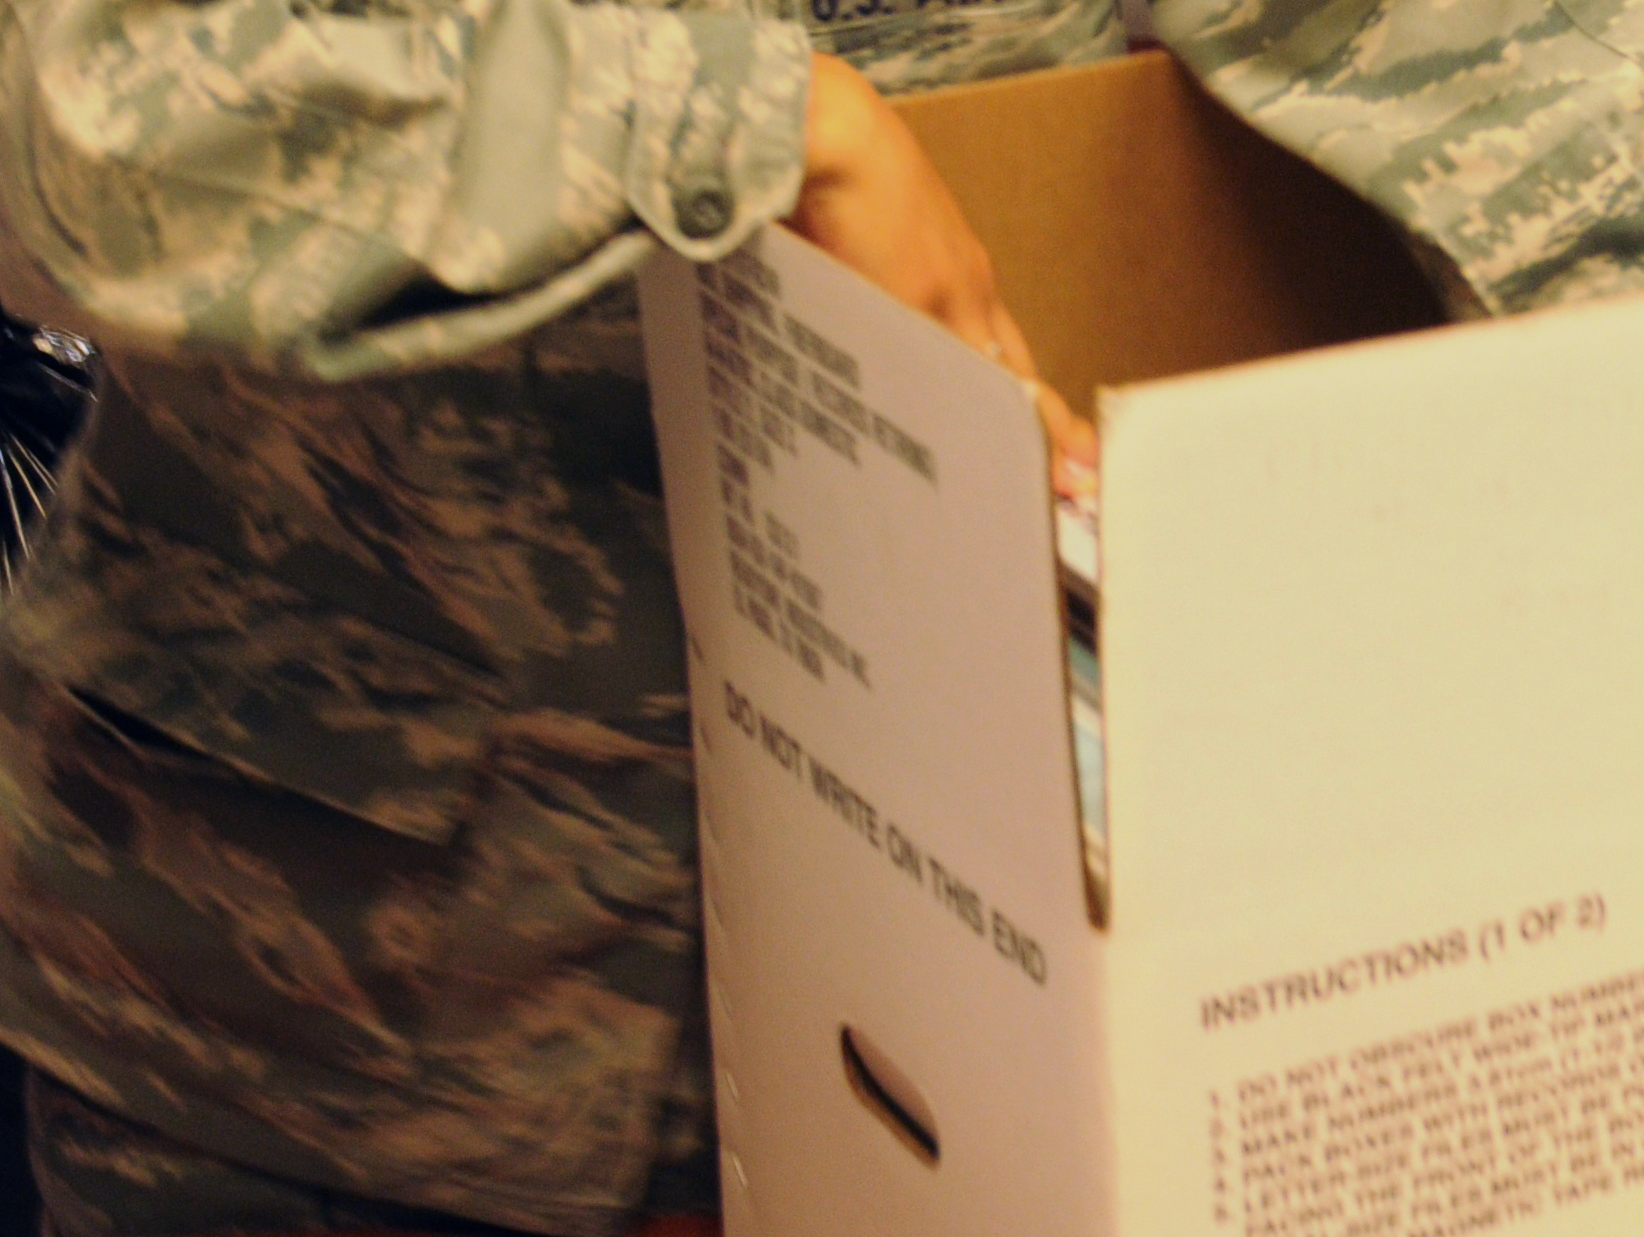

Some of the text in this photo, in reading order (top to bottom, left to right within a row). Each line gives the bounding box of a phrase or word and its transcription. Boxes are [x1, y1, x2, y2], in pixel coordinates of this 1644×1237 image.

[724, 680, 1047, 988] DO NOT WRITE ON THIS END
[1200, 889, 1607, 1032] INSTRUCTIONS (1 OF 2)
[1239, 1071, 1278, 1101] DO
[1285, 1054, 1337, 1088] NOT
[1349, 1015, 1477, 1070] OBSCURE
[1489, 998, 1540, 1031] BOX
[1303, 1070, 1392, 1113] BLACK
[1403, 1050, 1463, 1084] FELT
[1241, 1118, 1316, 1158] MAKE
[1328, 1078, 1456, 1133] NUMBERS
[1243, 1148, 1312, 1186] PACK
[1325, 1119, 1413, 1163] BOXES
[1422, 1098, 1488, 1134] WITH
[1497, 1060, 1619, 1112] RECORDS
[1422, 1122, 1492, 1162] FILES
[1502, 1098, 1572, 1138] MUST
[1581, 1087, 1610, 1115] BE
[1355, 1179, 1399, 1209] THE
[1414, 1151, 1496, 1192] FRONT
[1508, 1139, 1537, 1164] OF
[1554, 1122, 1595, 1151] THE
[1411, 1182, 1481, 1221] FILES
[1491, 1159, 1558, 1197] MUST
[1570, 1147, 1598, 1173] BE
[1611, 1136, 1633, 1161] IN
[1554, 1171, 1610, 1205] TAPE
